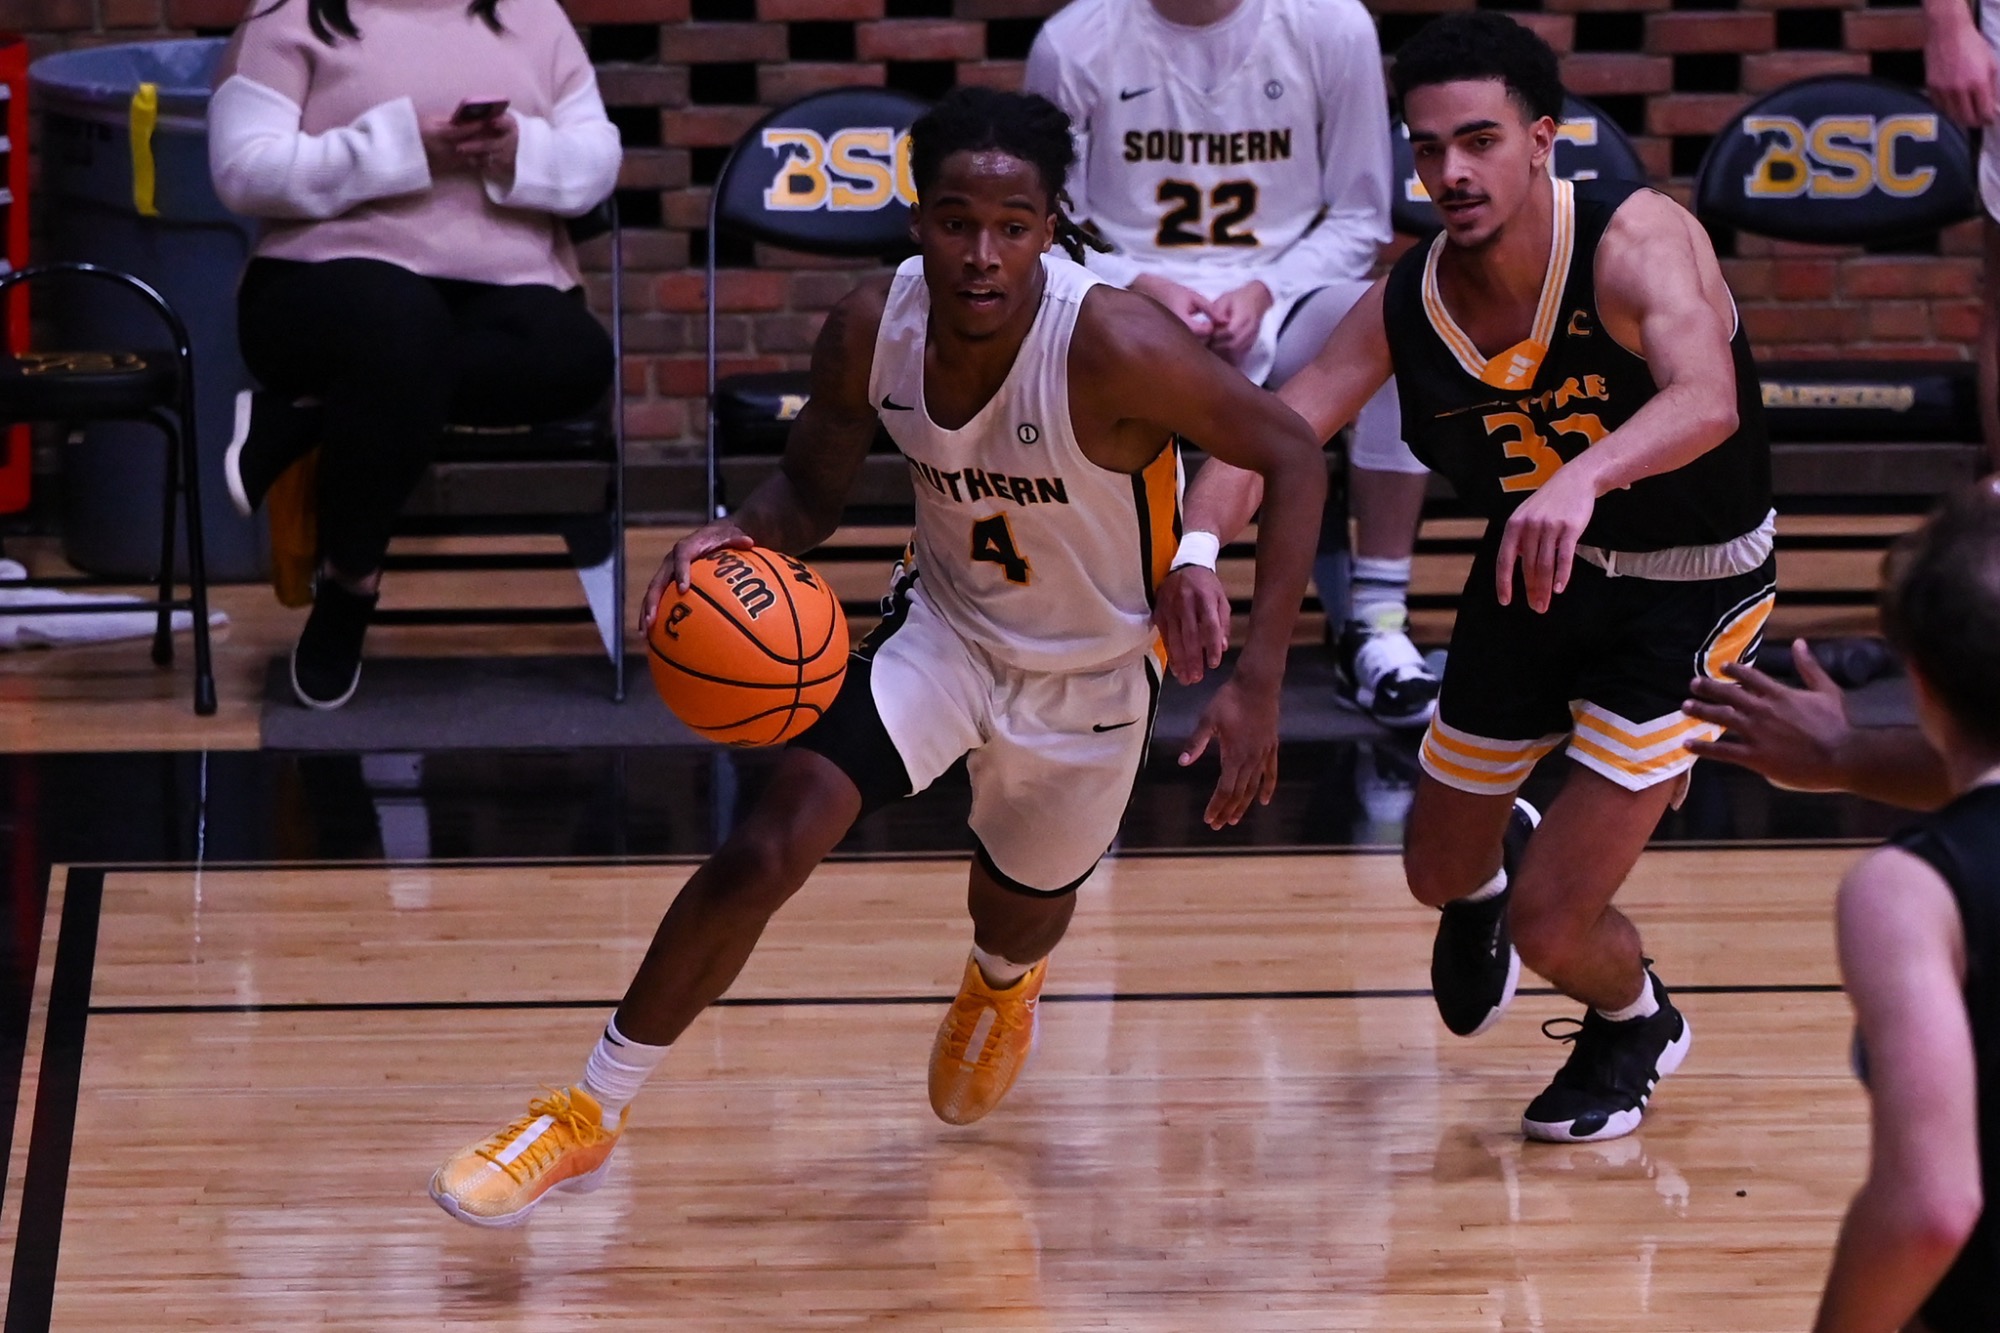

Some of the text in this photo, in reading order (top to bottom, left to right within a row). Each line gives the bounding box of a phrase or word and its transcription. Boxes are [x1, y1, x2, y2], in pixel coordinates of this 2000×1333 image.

[762, 127, 920, 212] BS
[1122, 127, 1292, 166] SOUTHERN
[1742, 113, 1939, 199] BSC
[1155, 176, 1261, 249] 22
[904, 454, 1069, 507] UTHERN
[970, 510, 1032, 587] 4
